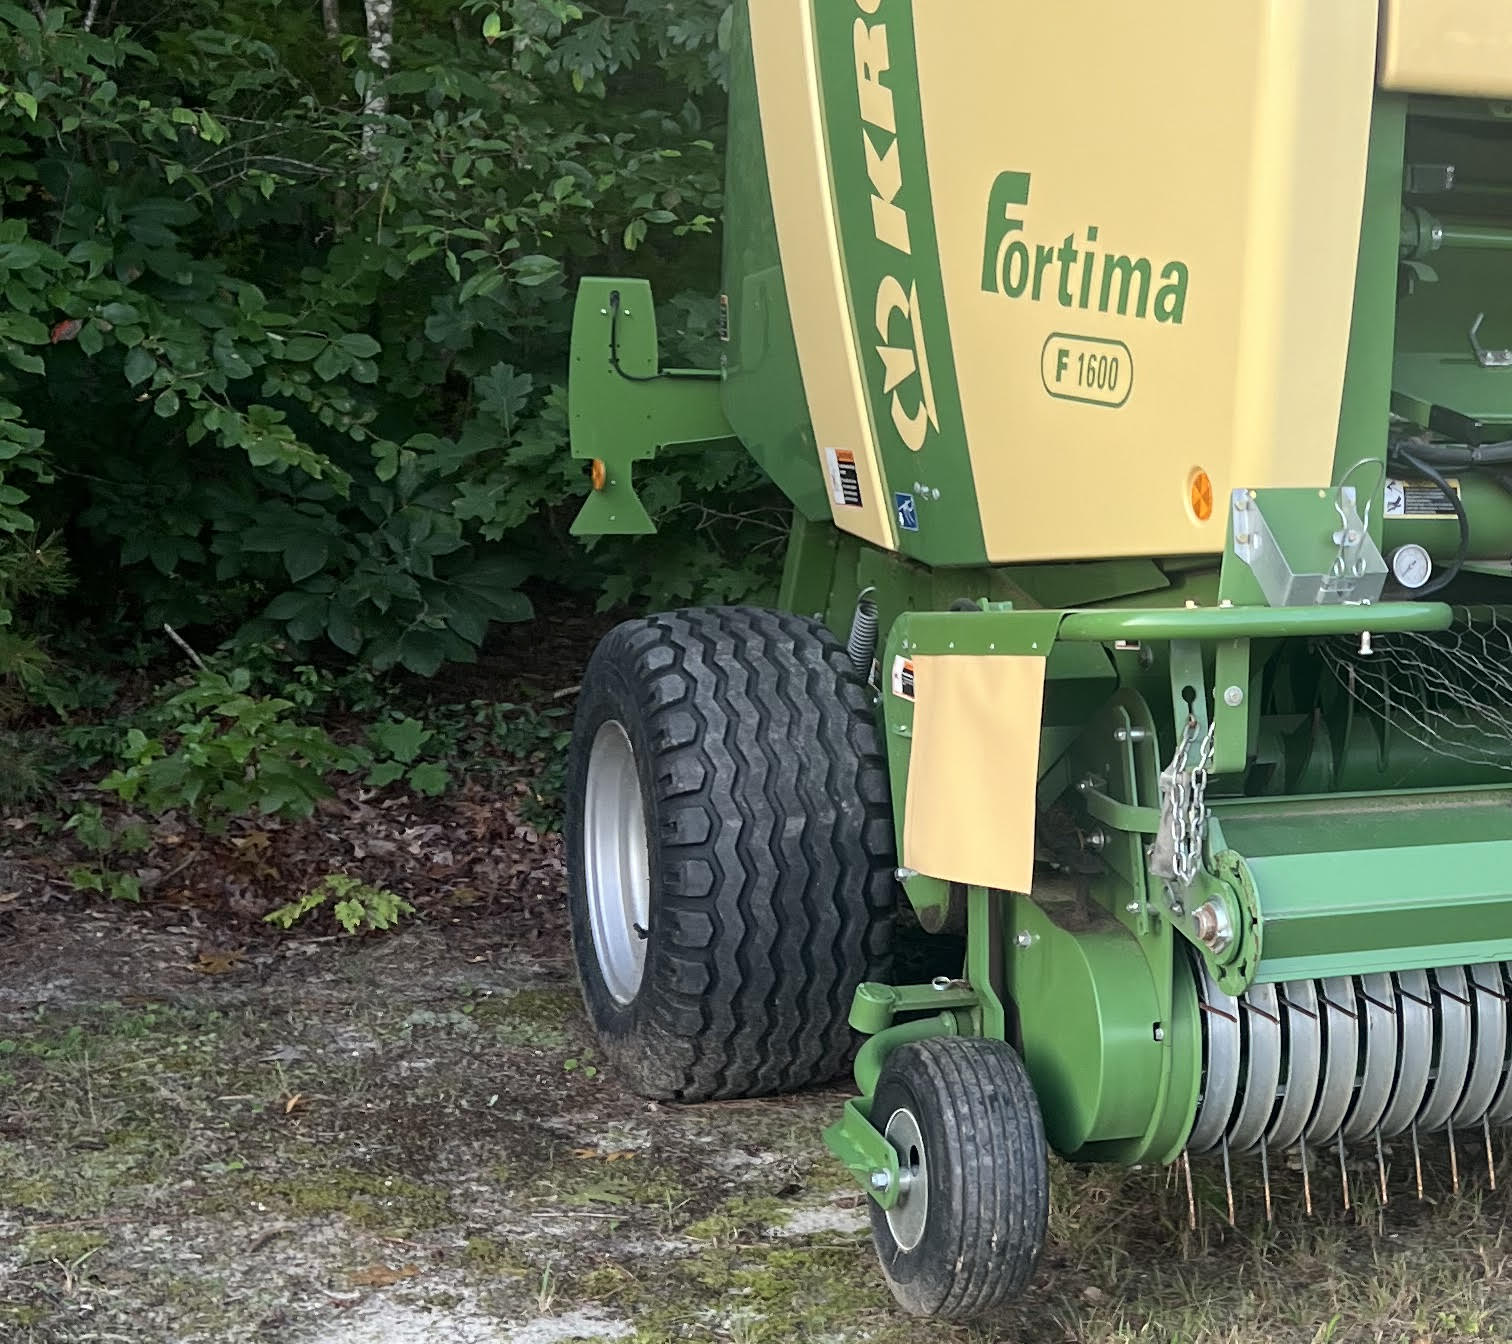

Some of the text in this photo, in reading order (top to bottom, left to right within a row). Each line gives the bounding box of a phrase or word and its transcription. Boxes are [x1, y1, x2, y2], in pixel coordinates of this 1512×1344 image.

[980, 170, 1189, 325] Fortima
[1055, 348, 1119, 392] F 1600
